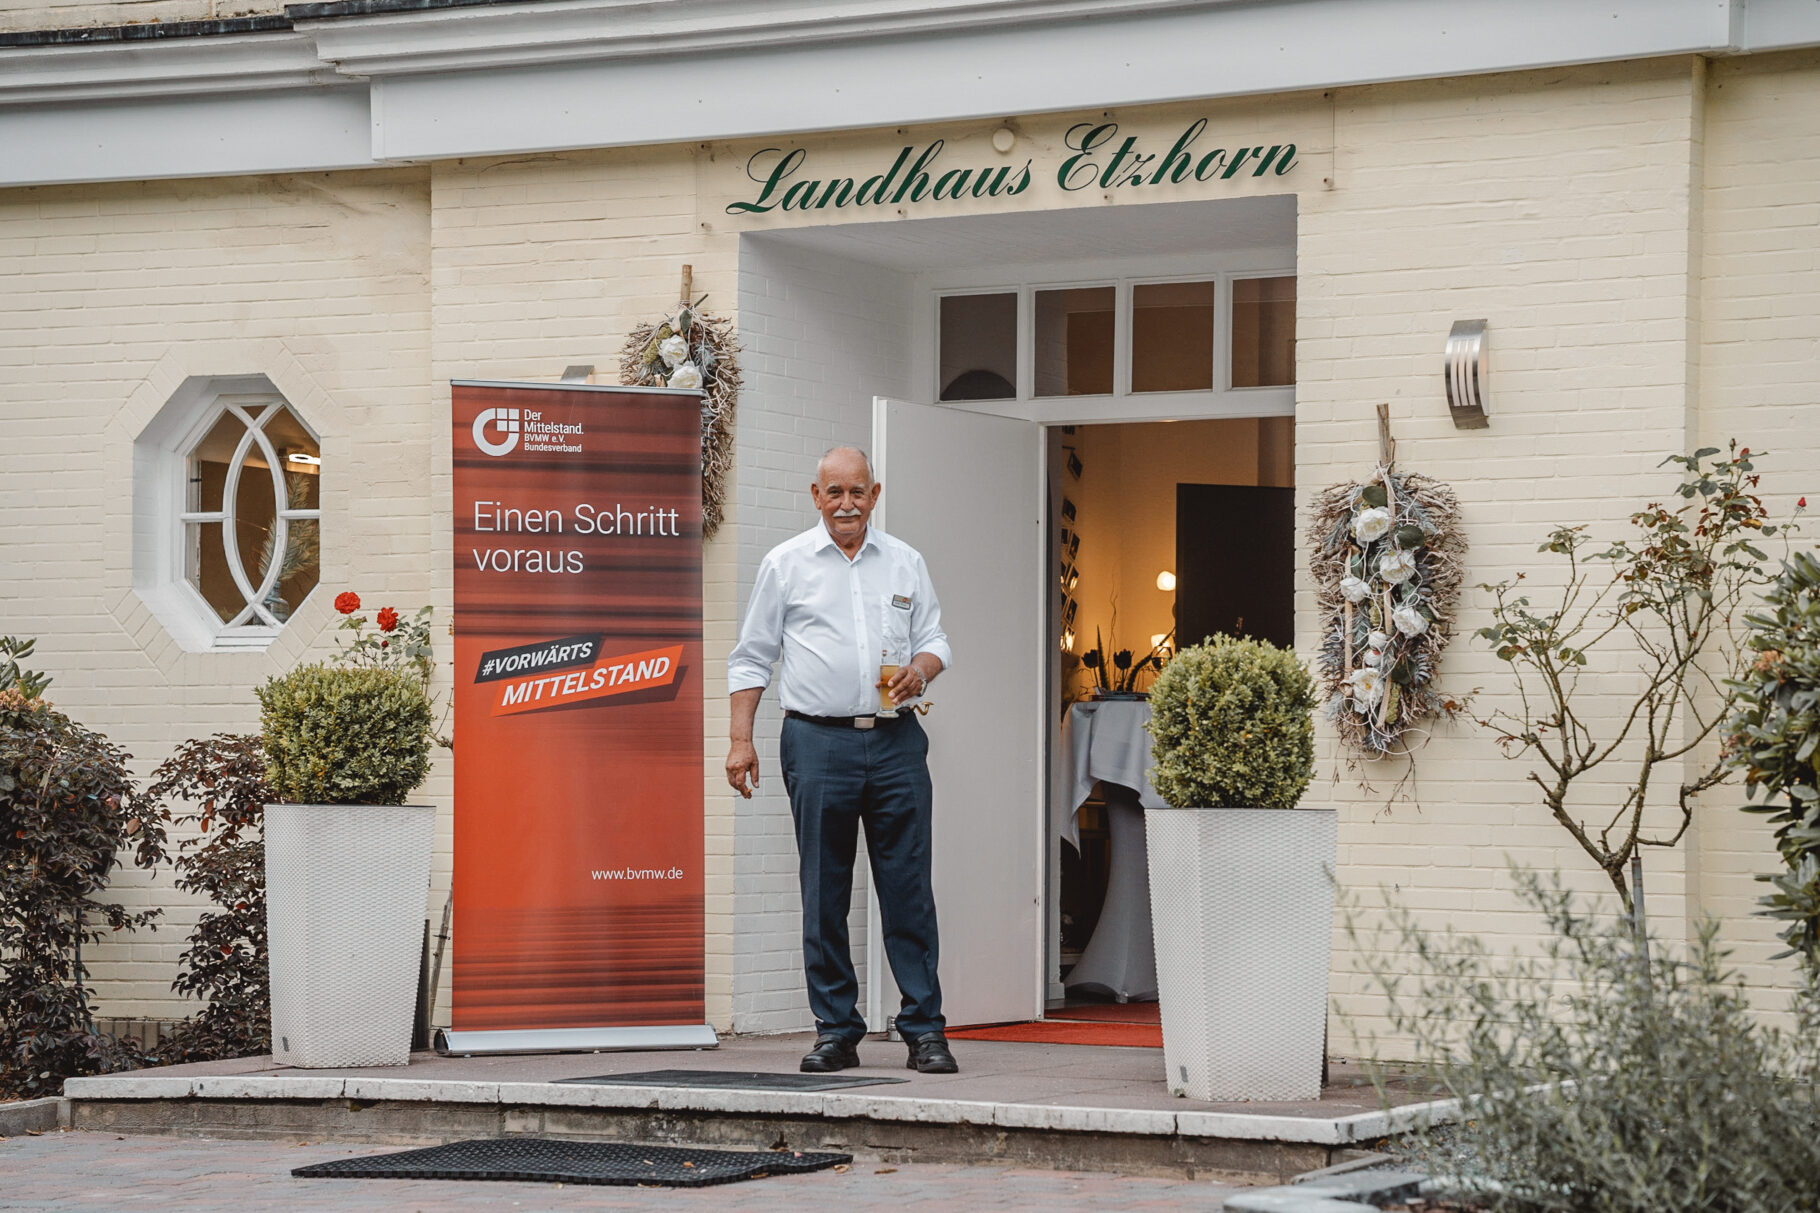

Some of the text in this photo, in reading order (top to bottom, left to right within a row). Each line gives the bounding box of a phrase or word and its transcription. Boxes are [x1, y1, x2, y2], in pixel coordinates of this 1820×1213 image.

[725, 117, 1299, 215] Landhaus Etzhorn
[524, 409, 542, 420] Der
[524, 421, 584, 434] Mittelstand.
[524, 433, 566, 443] BVMW e.V.
[524, 442, 582, 452] Bundesverband
[474, 501, 680, 537] Einen Schritt
[473, 548, 584, 574] voraus
[482, 641, 593, 676] #VORWÄRTS
[501, 656, 670, 707] MITTELSTAND
[591, 866, 684, 880] www.bvmw.de
